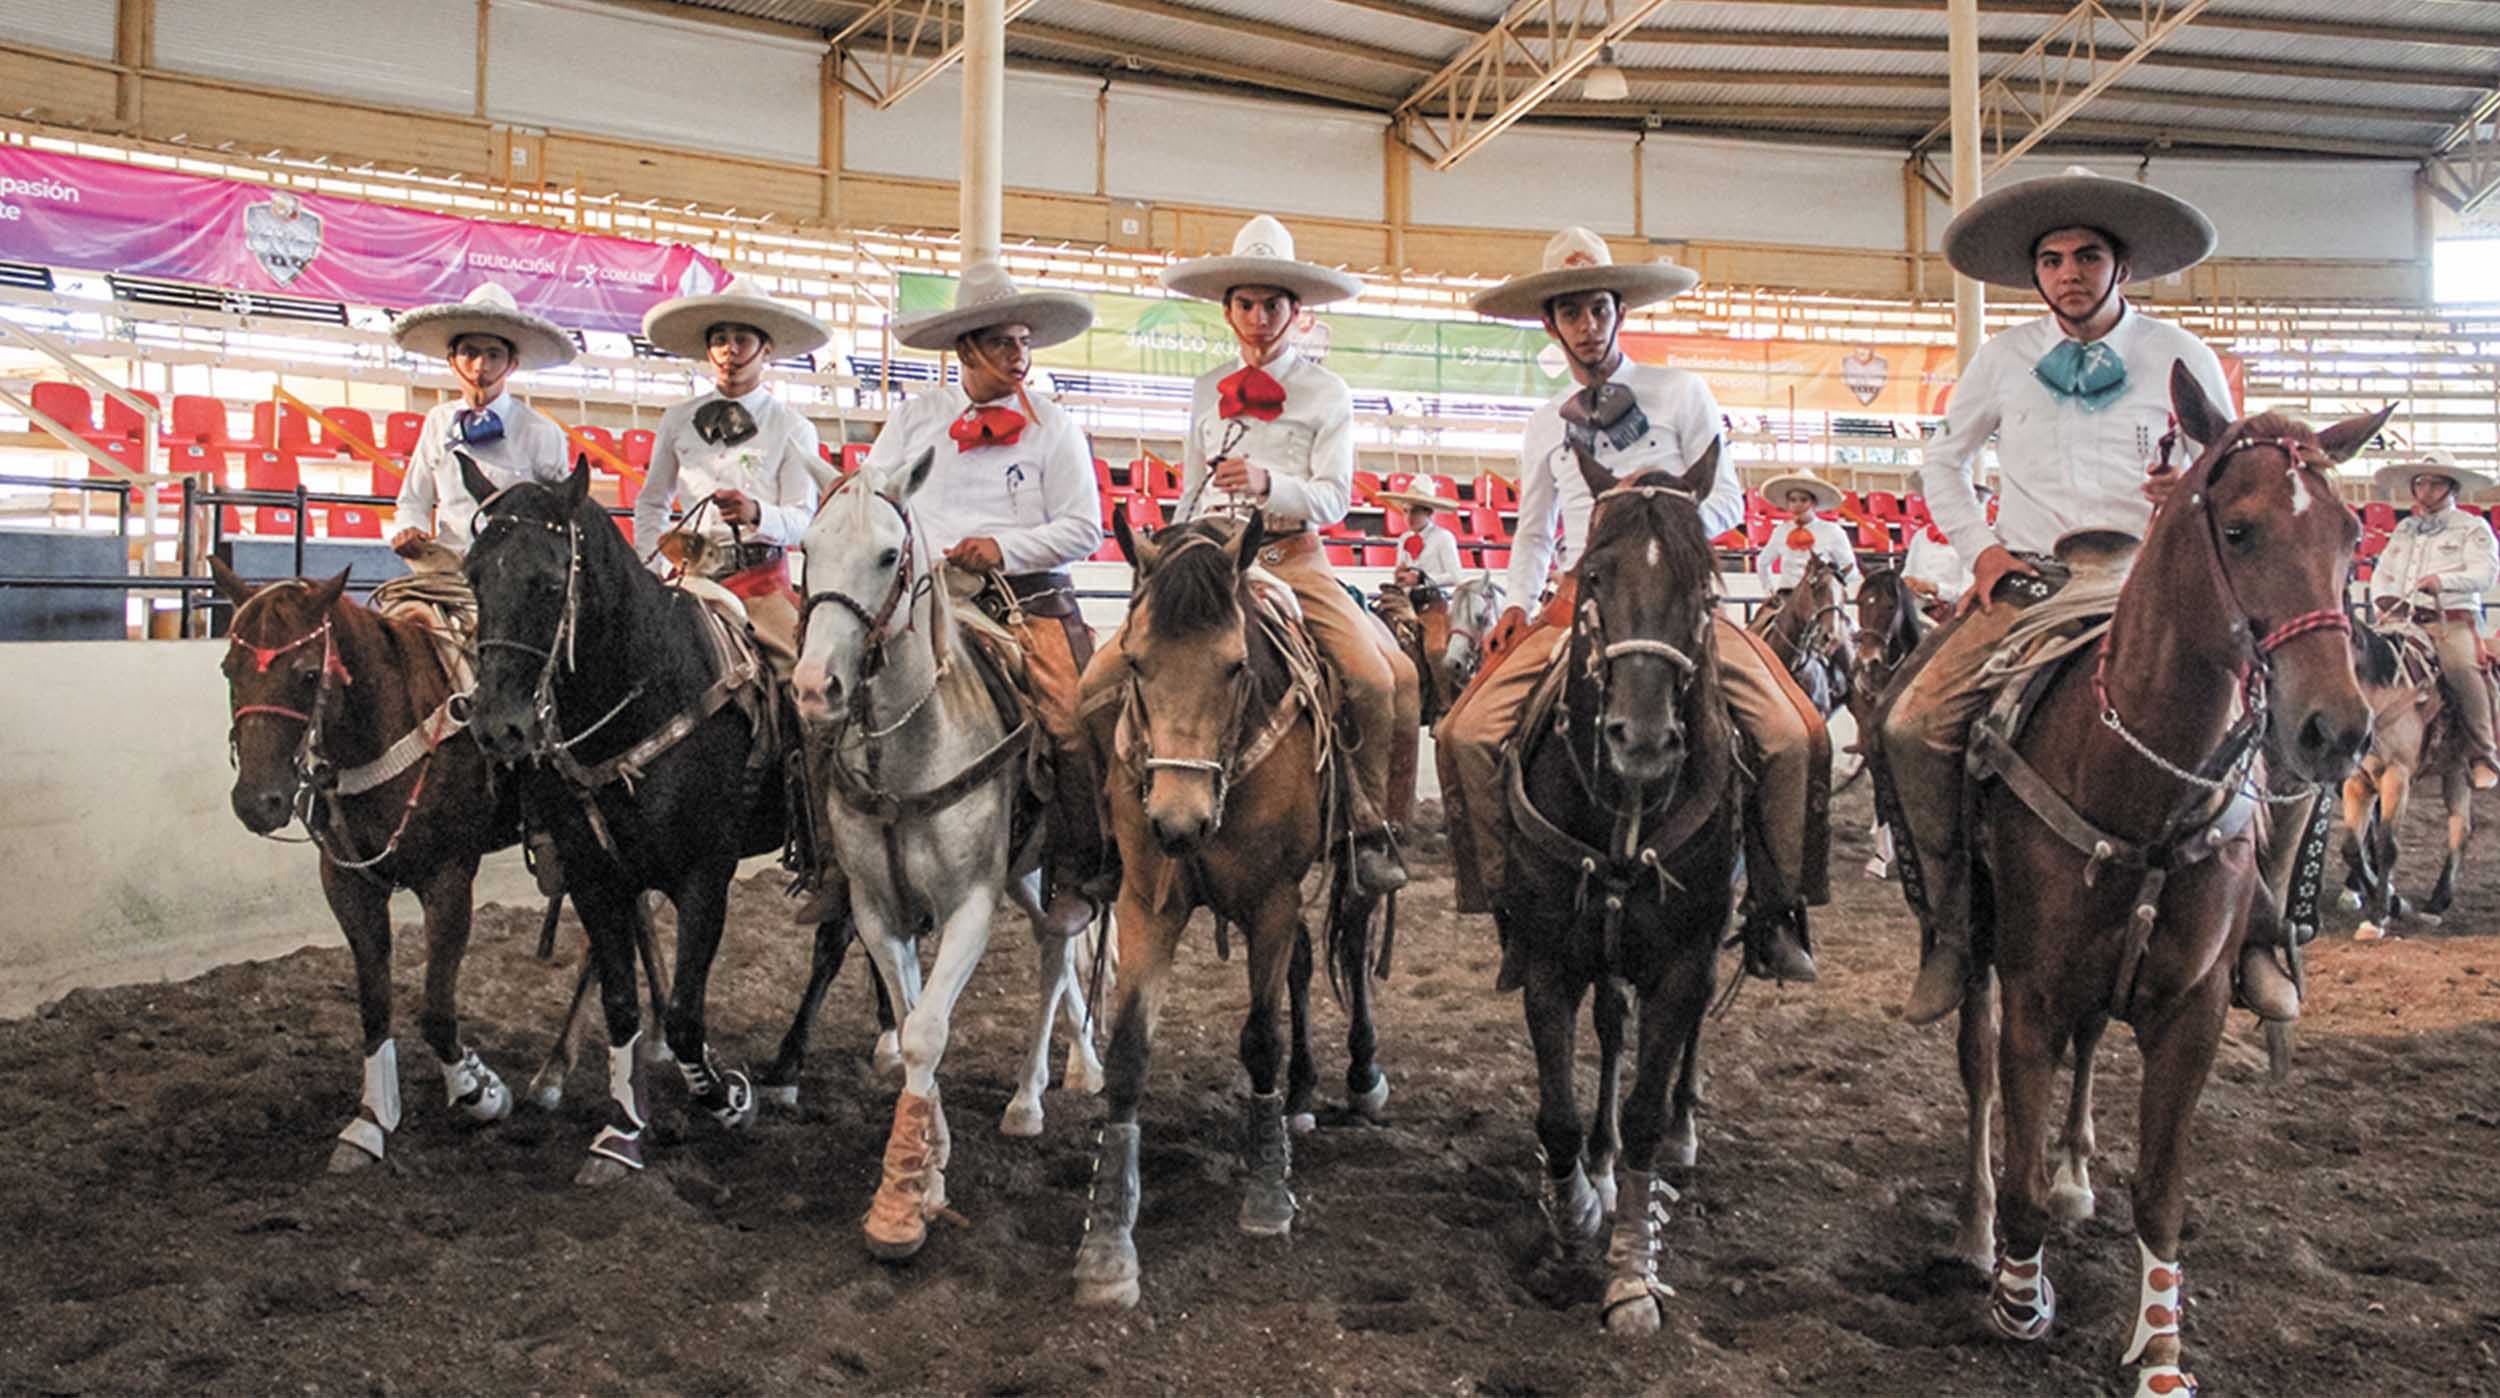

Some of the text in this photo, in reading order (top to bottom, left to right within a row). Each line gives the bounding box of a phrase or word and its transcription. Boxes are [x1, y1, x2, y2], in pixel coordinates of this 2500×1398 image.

[0, 176, 79, 204] pasión
[468, 252, 555, 274] EDUCACIÓN
[600, 268, 657, 285] CONADE
[1126, 328, 1207, 352] JALISCO
